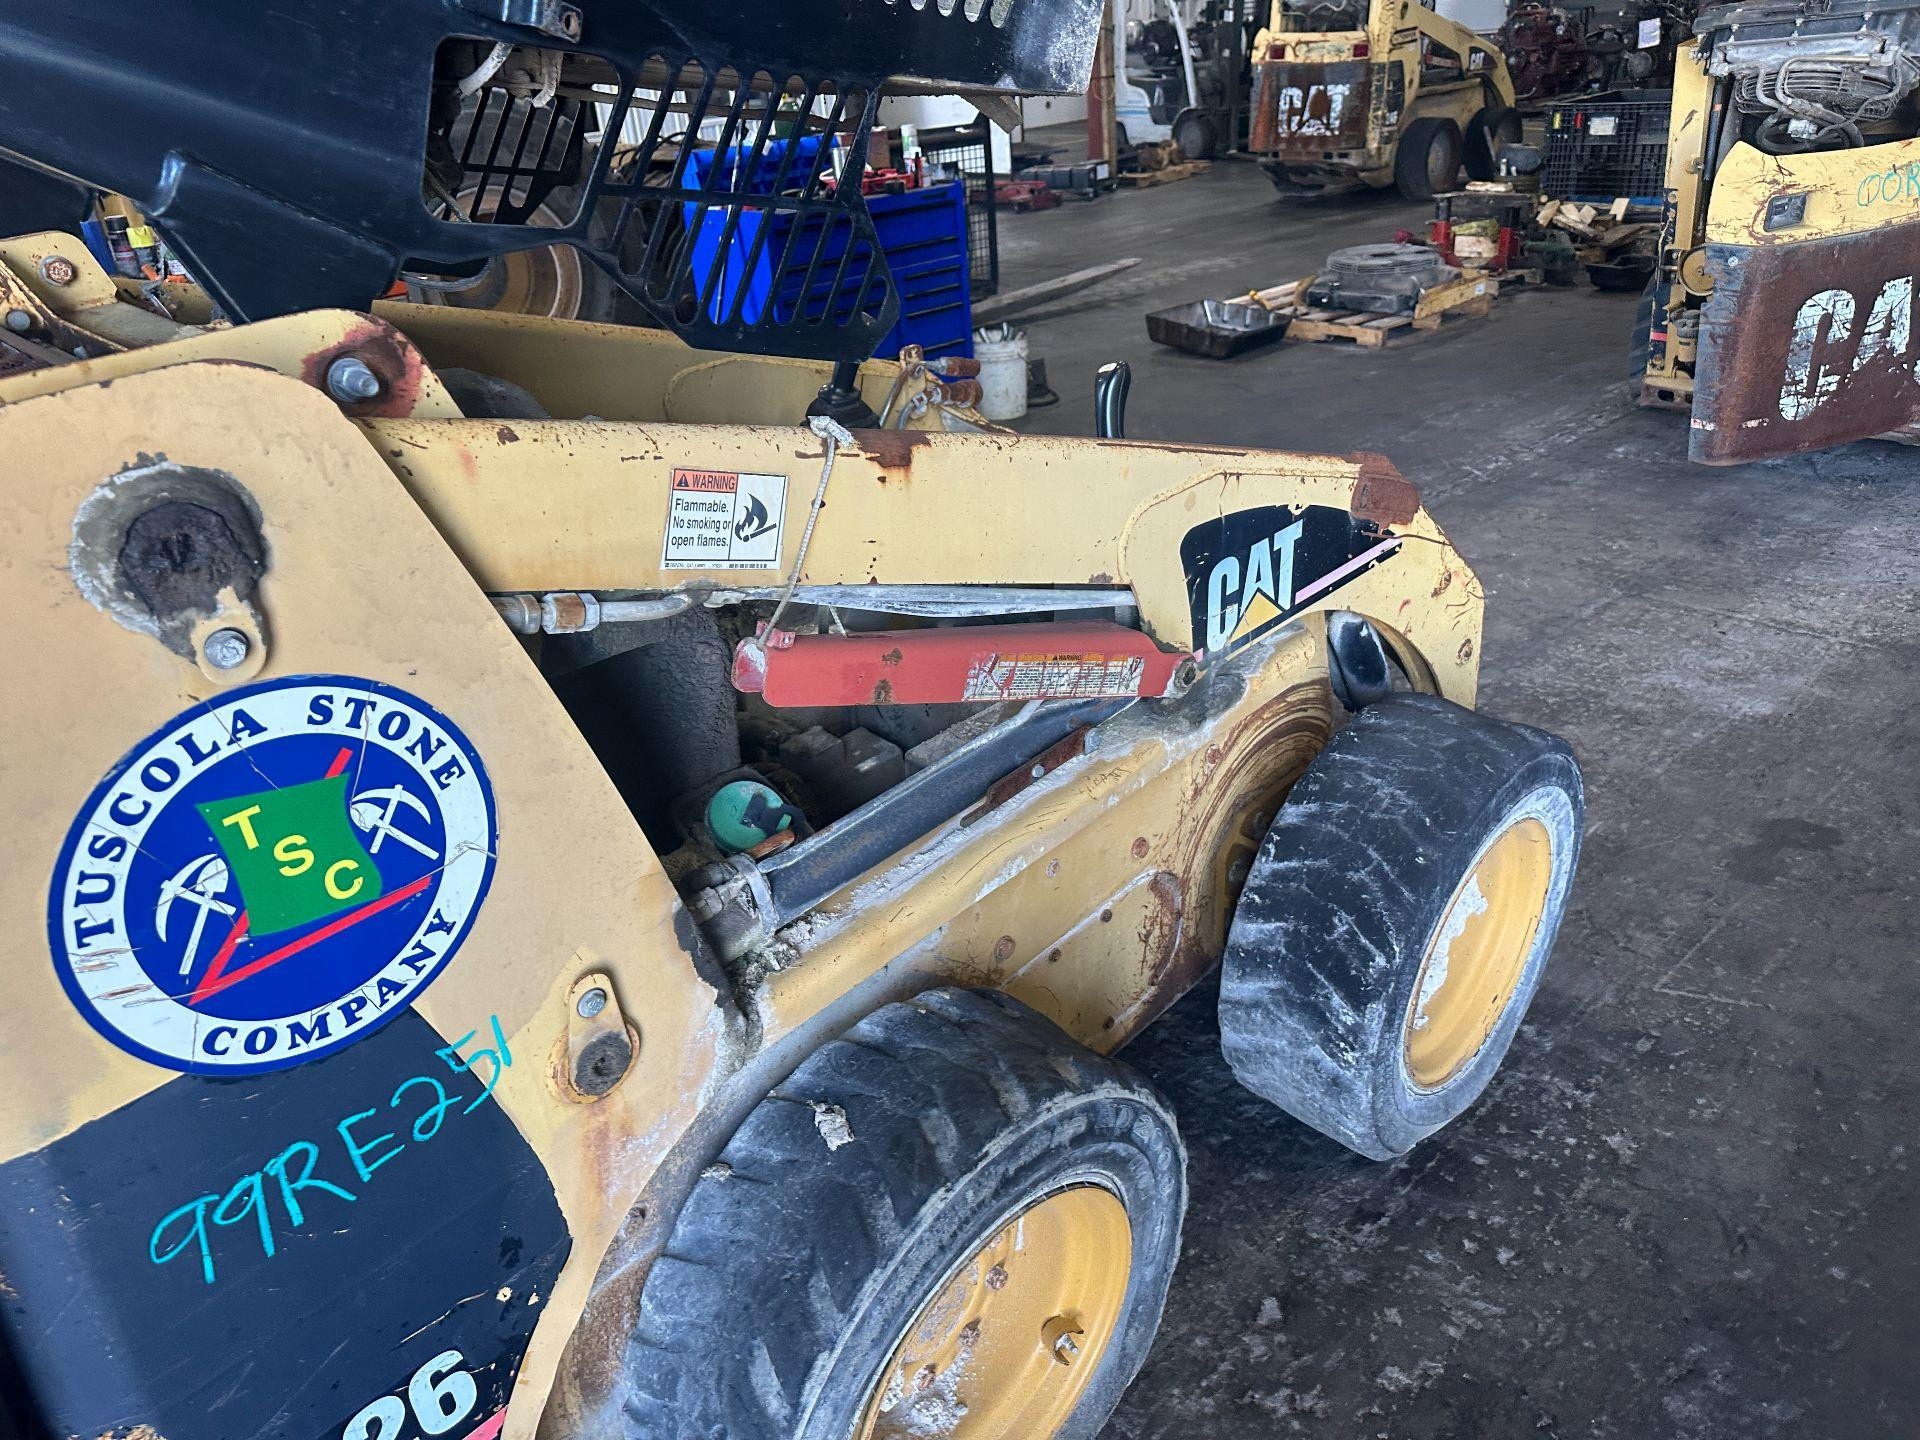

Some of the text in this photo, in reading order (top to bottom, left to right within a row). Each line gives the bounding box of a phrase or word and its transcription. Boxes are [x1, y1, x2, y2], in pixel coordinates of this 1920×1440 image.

[1278, 84, 1350, 137] CAT
[1779, 276, 1920, 421] CA
[675, 498, 729, 513] Flammable.
[692, 474, 735, 490] WARNING
[671, 534, 729, 549] open flames.
[673, 516, 731, 533] No smoking or
[1207, 519, 1303, 652] CAT
[75, 694, 467, 950] TUSCOLA STONE
[201, 906, 458, 1057] COMPANY
